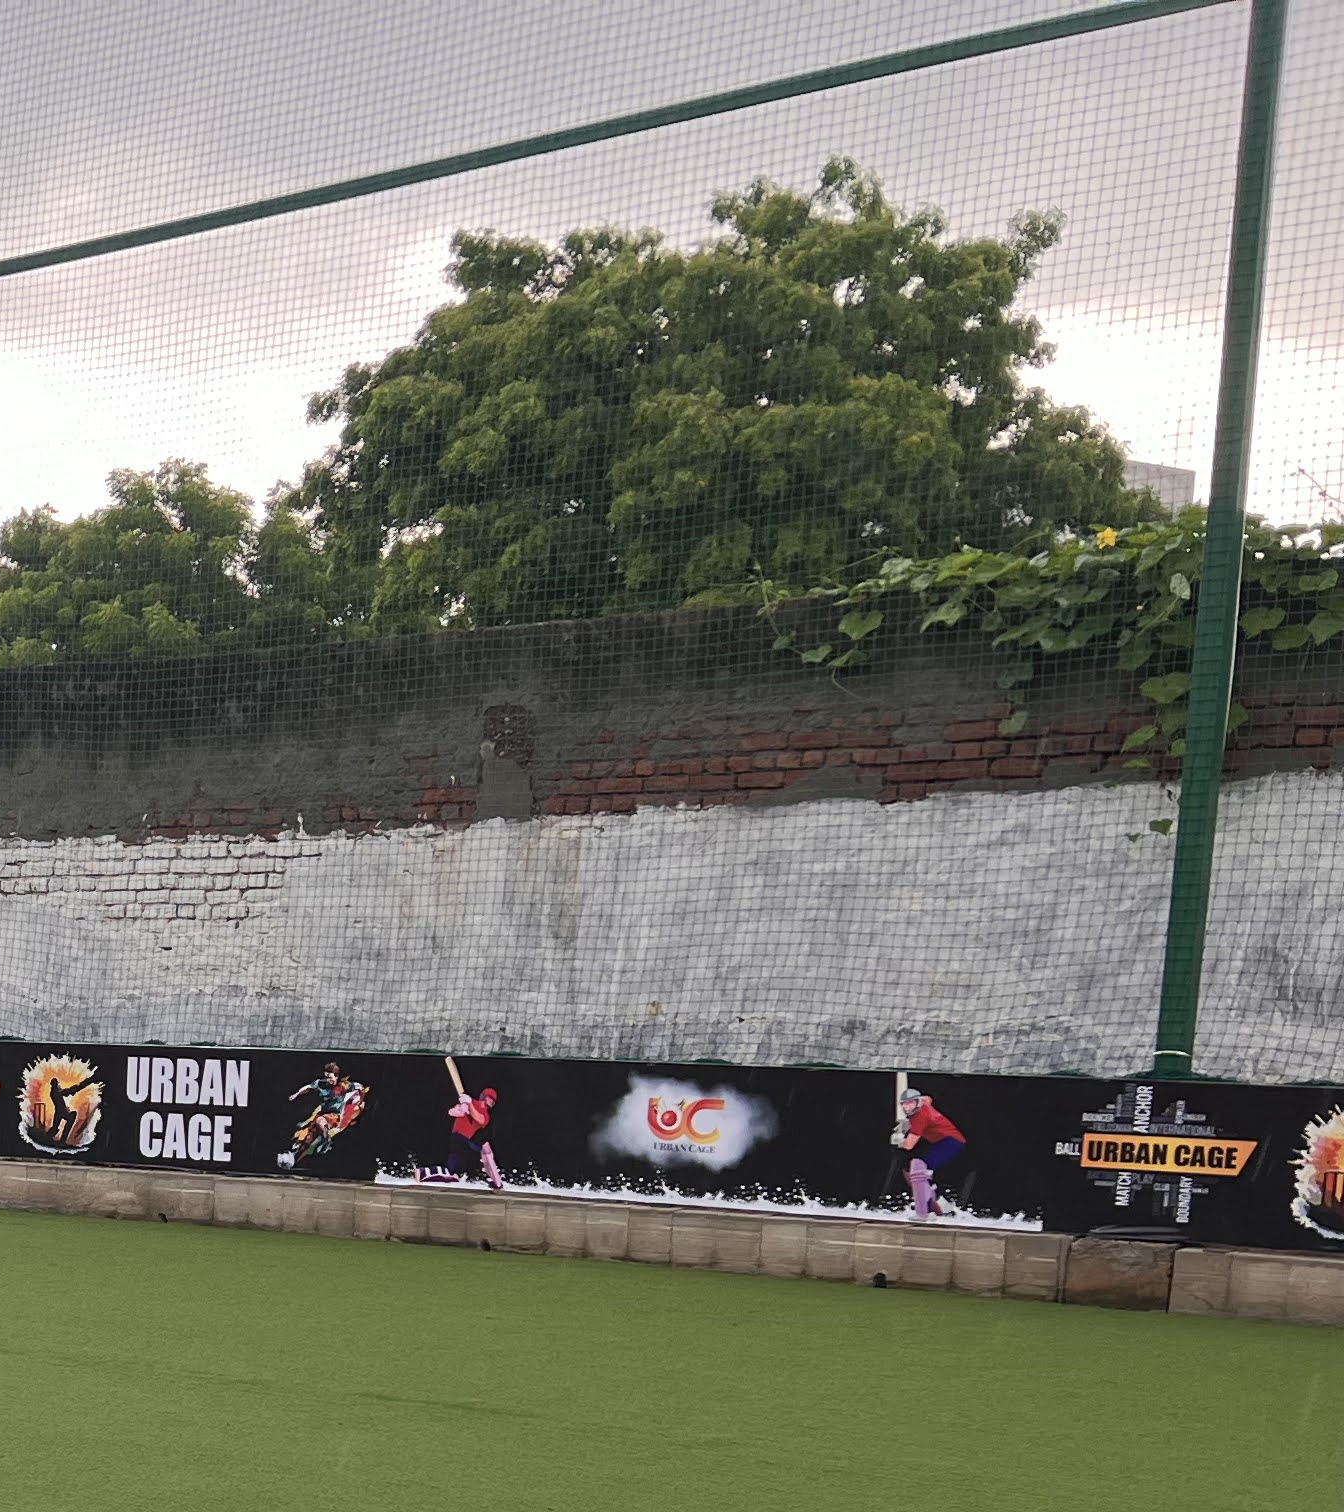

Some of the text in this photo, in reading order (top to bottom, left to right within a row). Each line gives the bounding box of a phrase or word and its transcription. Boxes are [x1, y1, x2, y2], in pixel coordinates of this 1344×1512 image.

[126, 1056, 251, 1107] URBAN
[1133, 1085, 1154, 1133] ANCHOR
[139, 1111, 232, 1162] CAGE
[1055, 1141, 1080, 1156] BALL
[1088, 1140, 1239, 1170] URBAN CAGE
[1114, 1171, 1132, 1206] MATCH
